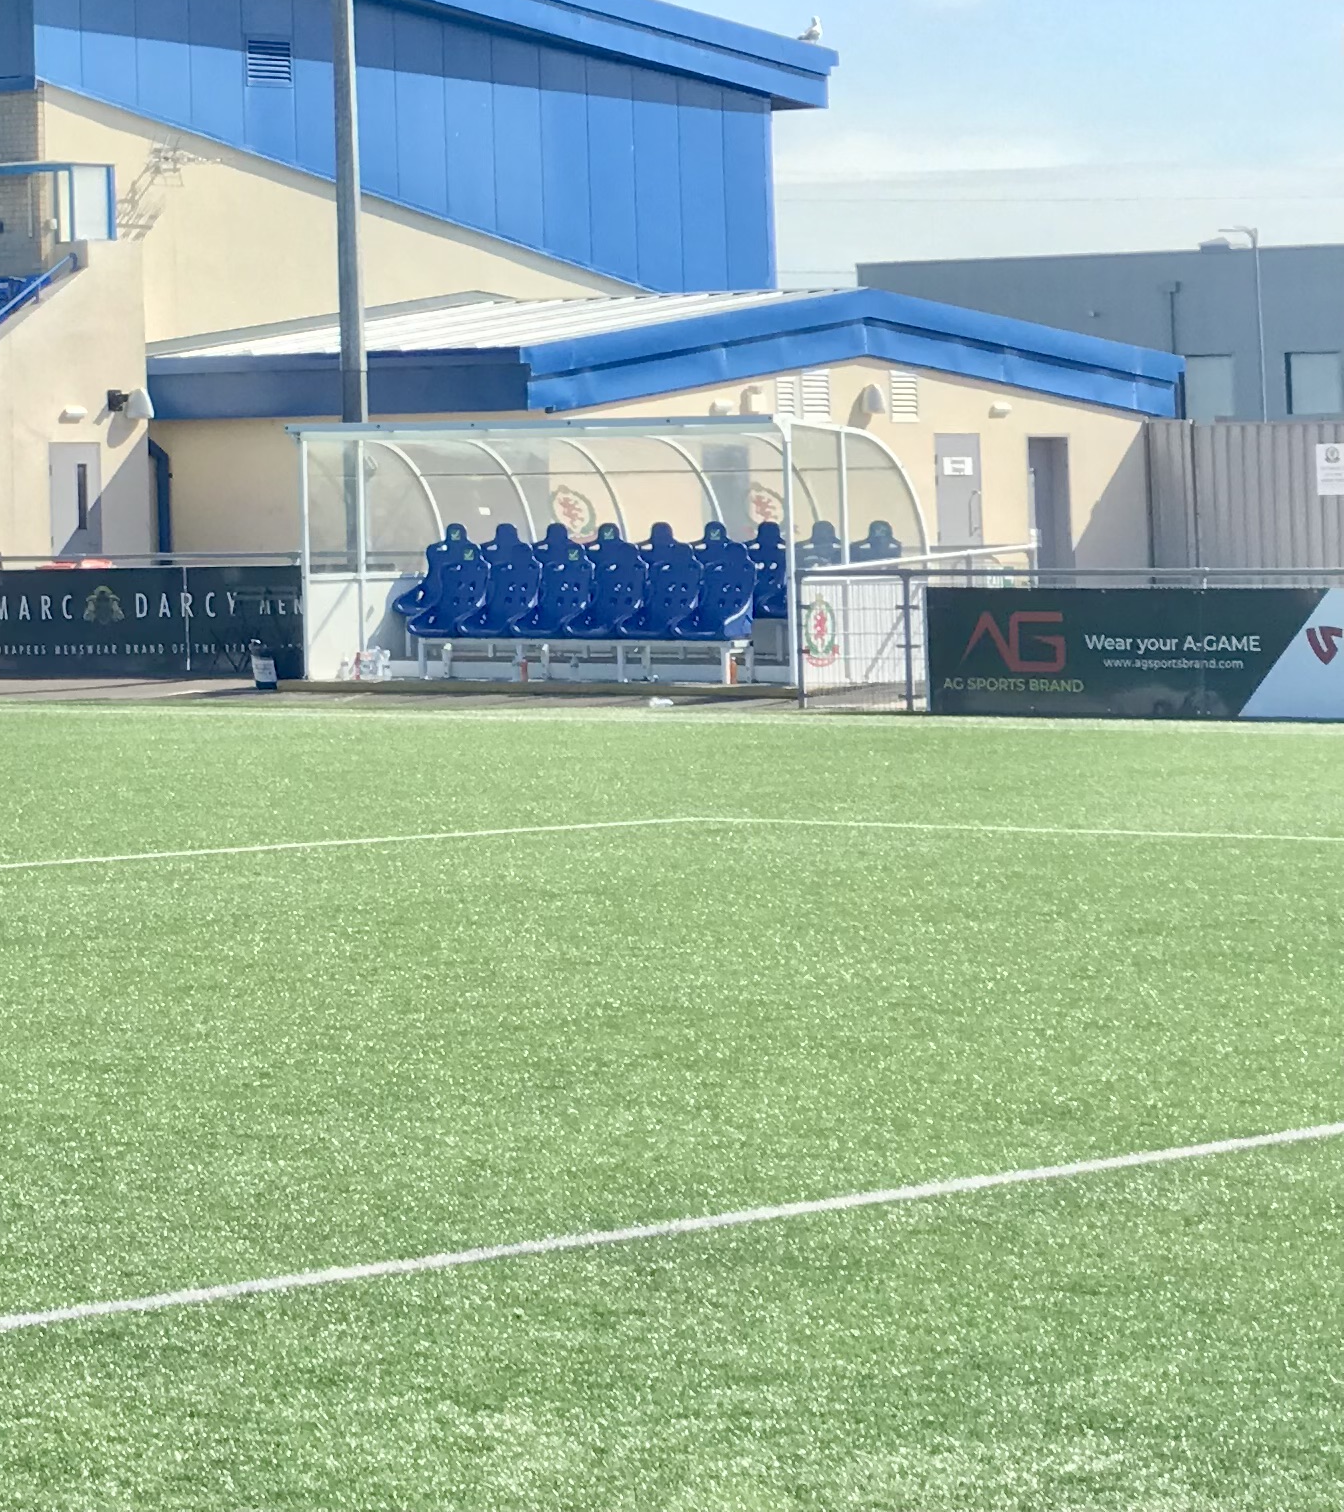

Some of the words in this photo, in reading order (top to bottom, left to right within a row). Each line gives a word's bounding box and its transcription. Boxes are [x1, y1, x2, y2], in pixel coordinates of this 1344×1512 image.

[135, 591, 238, 618] DARCY
[955, 611, 1066, 673] AG
[1085, 634, 1133, 651] Wear
[1137, 637, 1178, 654] your
[1183, 635, 1262, 652] A-GAME
[1103, 657, 1244, 671] www.agsportsbrand.com
[943, 678, 964, 690] AG
[967, 678, 1025, 691] SPORTS
[1029, 679, 1084, 693] BRAND
